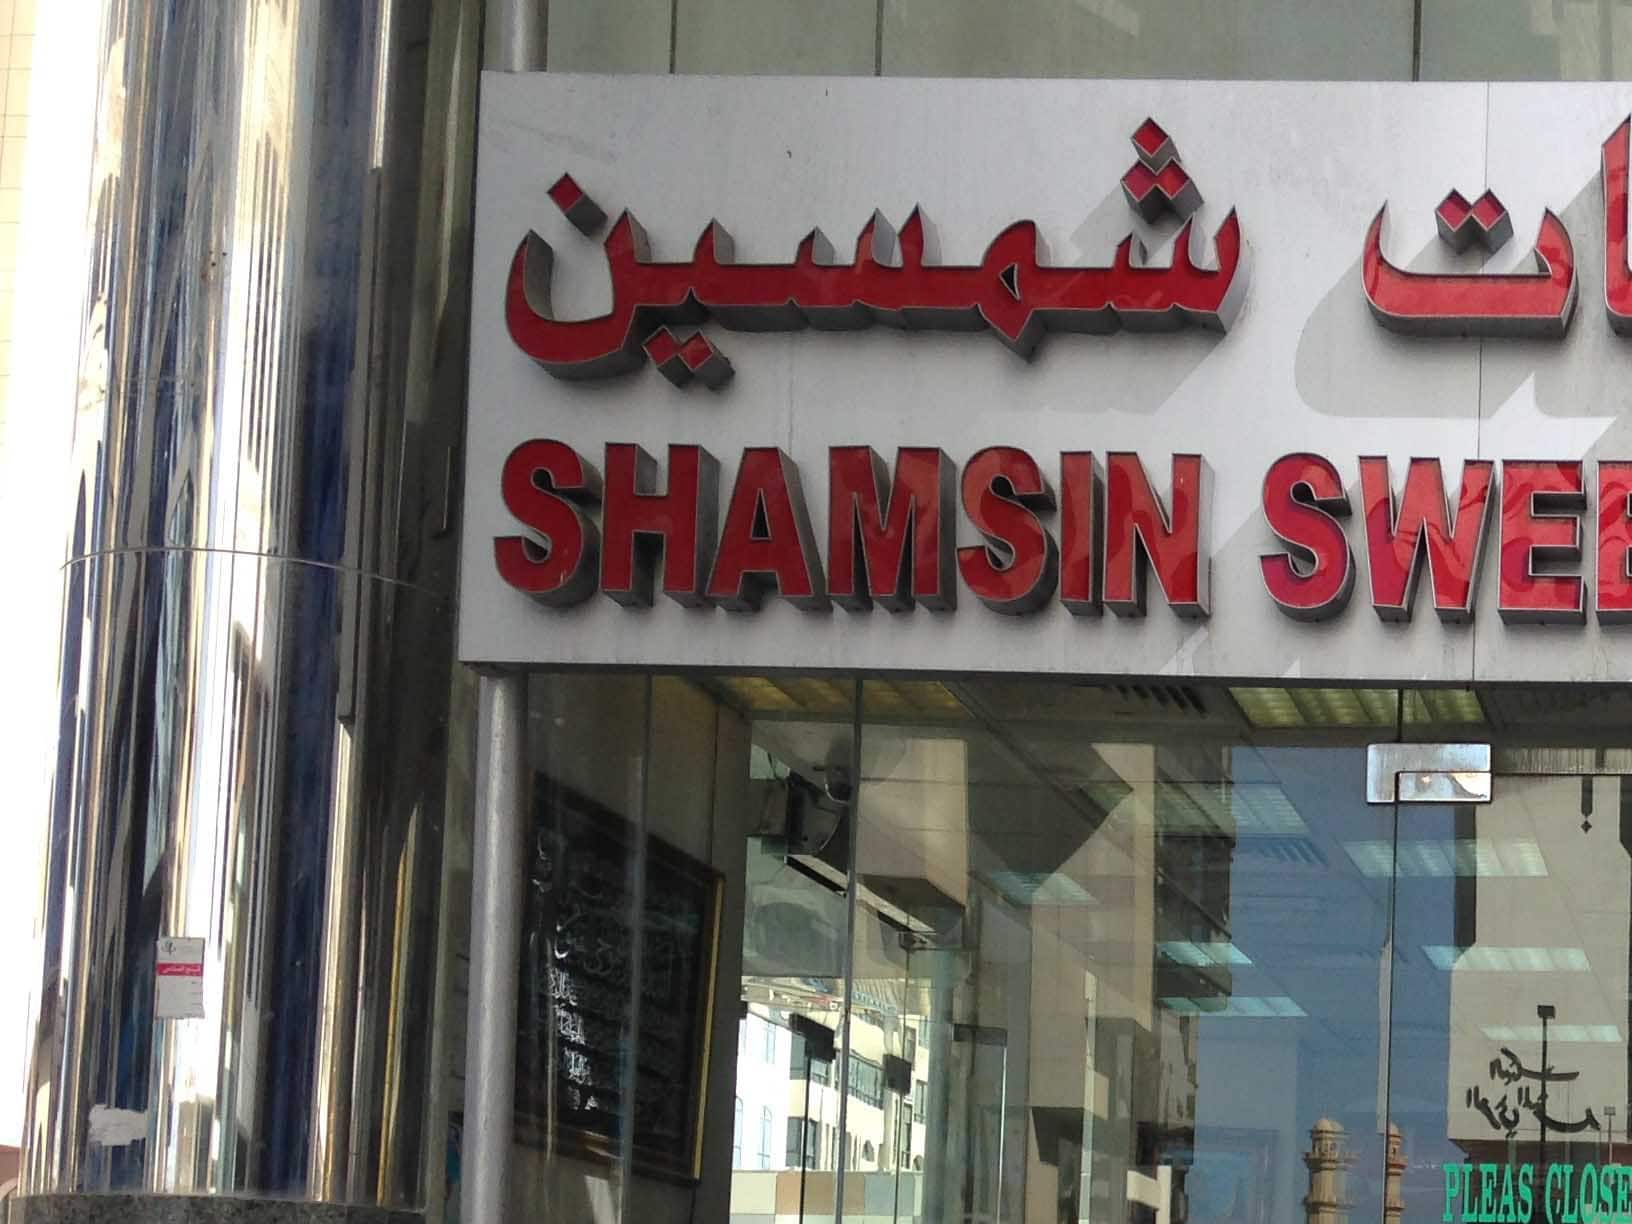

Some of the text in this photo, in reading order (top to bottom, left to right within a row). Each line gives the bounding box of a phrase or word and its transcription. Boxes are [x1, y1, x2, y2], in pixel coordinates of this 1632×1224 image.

[506, 117, 1241, 372] شمسين
[494, 439, 1206, 604] SHAMSIN
[1441, 1162, 1535, 1224] PLEAS
